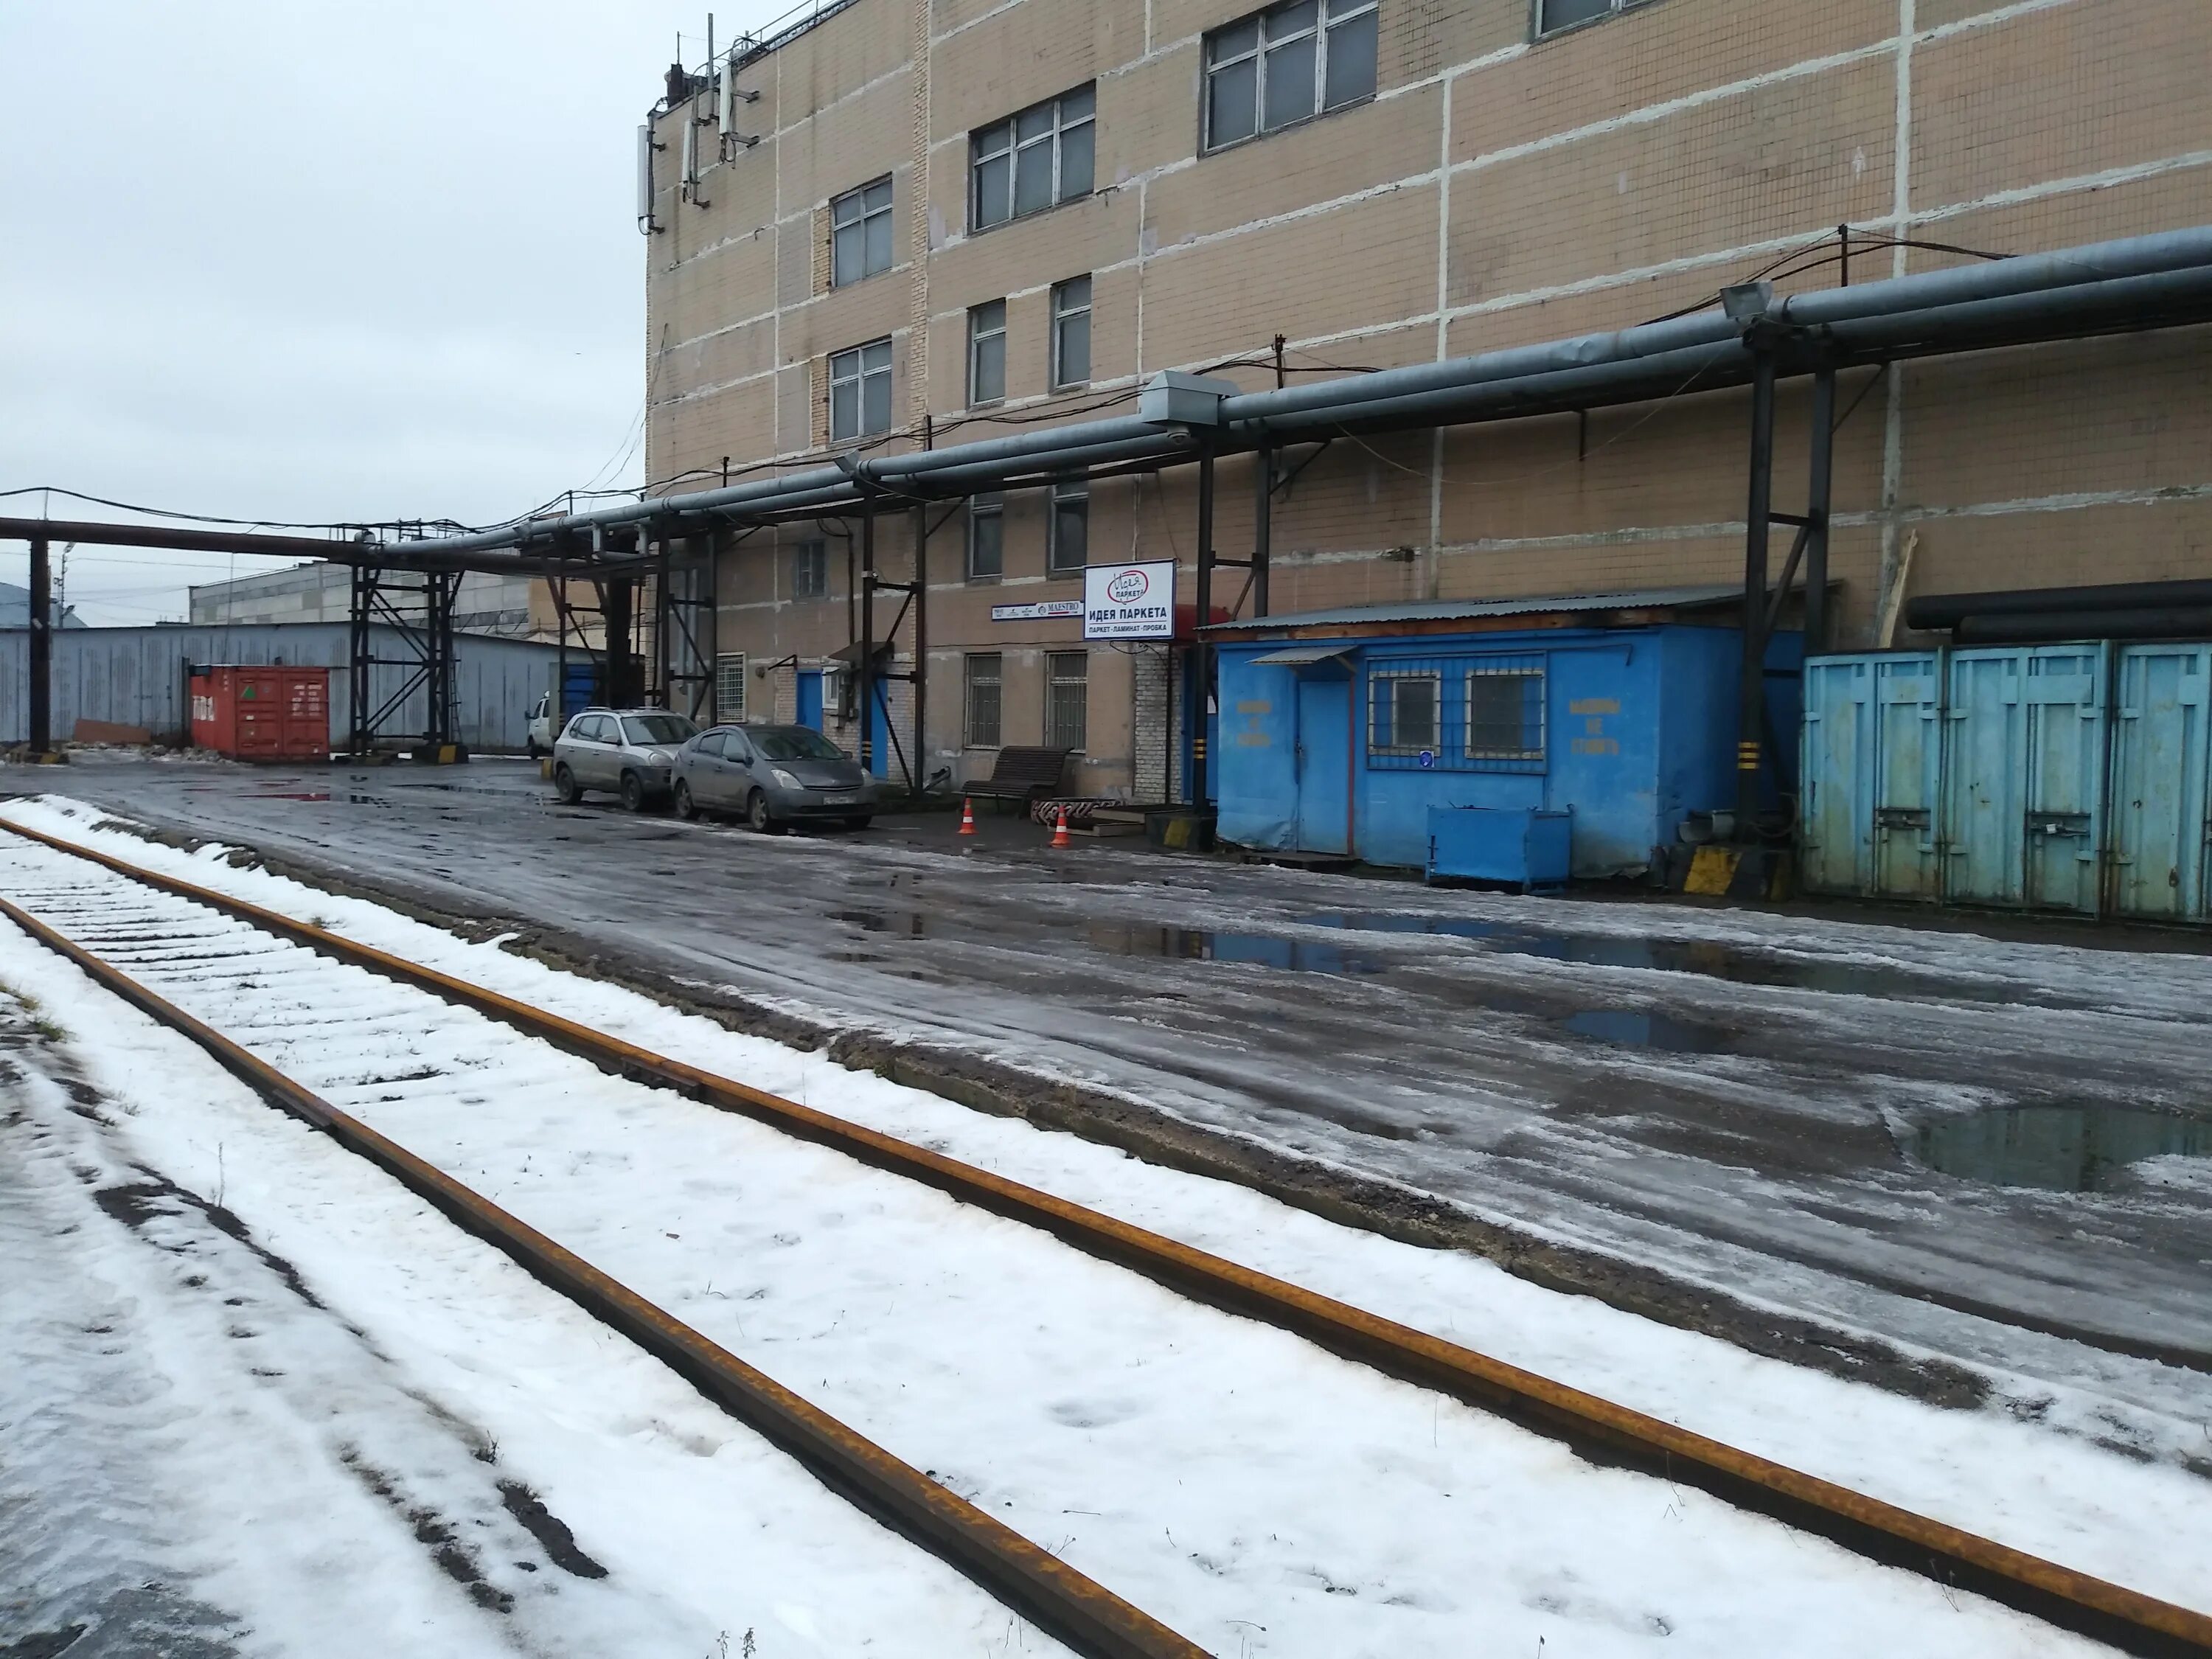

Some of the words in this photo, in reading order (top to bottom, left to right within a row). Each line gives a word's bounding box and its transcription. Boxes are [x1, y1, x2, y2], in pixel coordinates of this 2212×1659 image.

[1048, 602, 1079, 612] MAESTRO
[1090, 610, 1116, 622] ИДЕЯ
[1120, 607, 1166, 619] ПАРКЕТА
